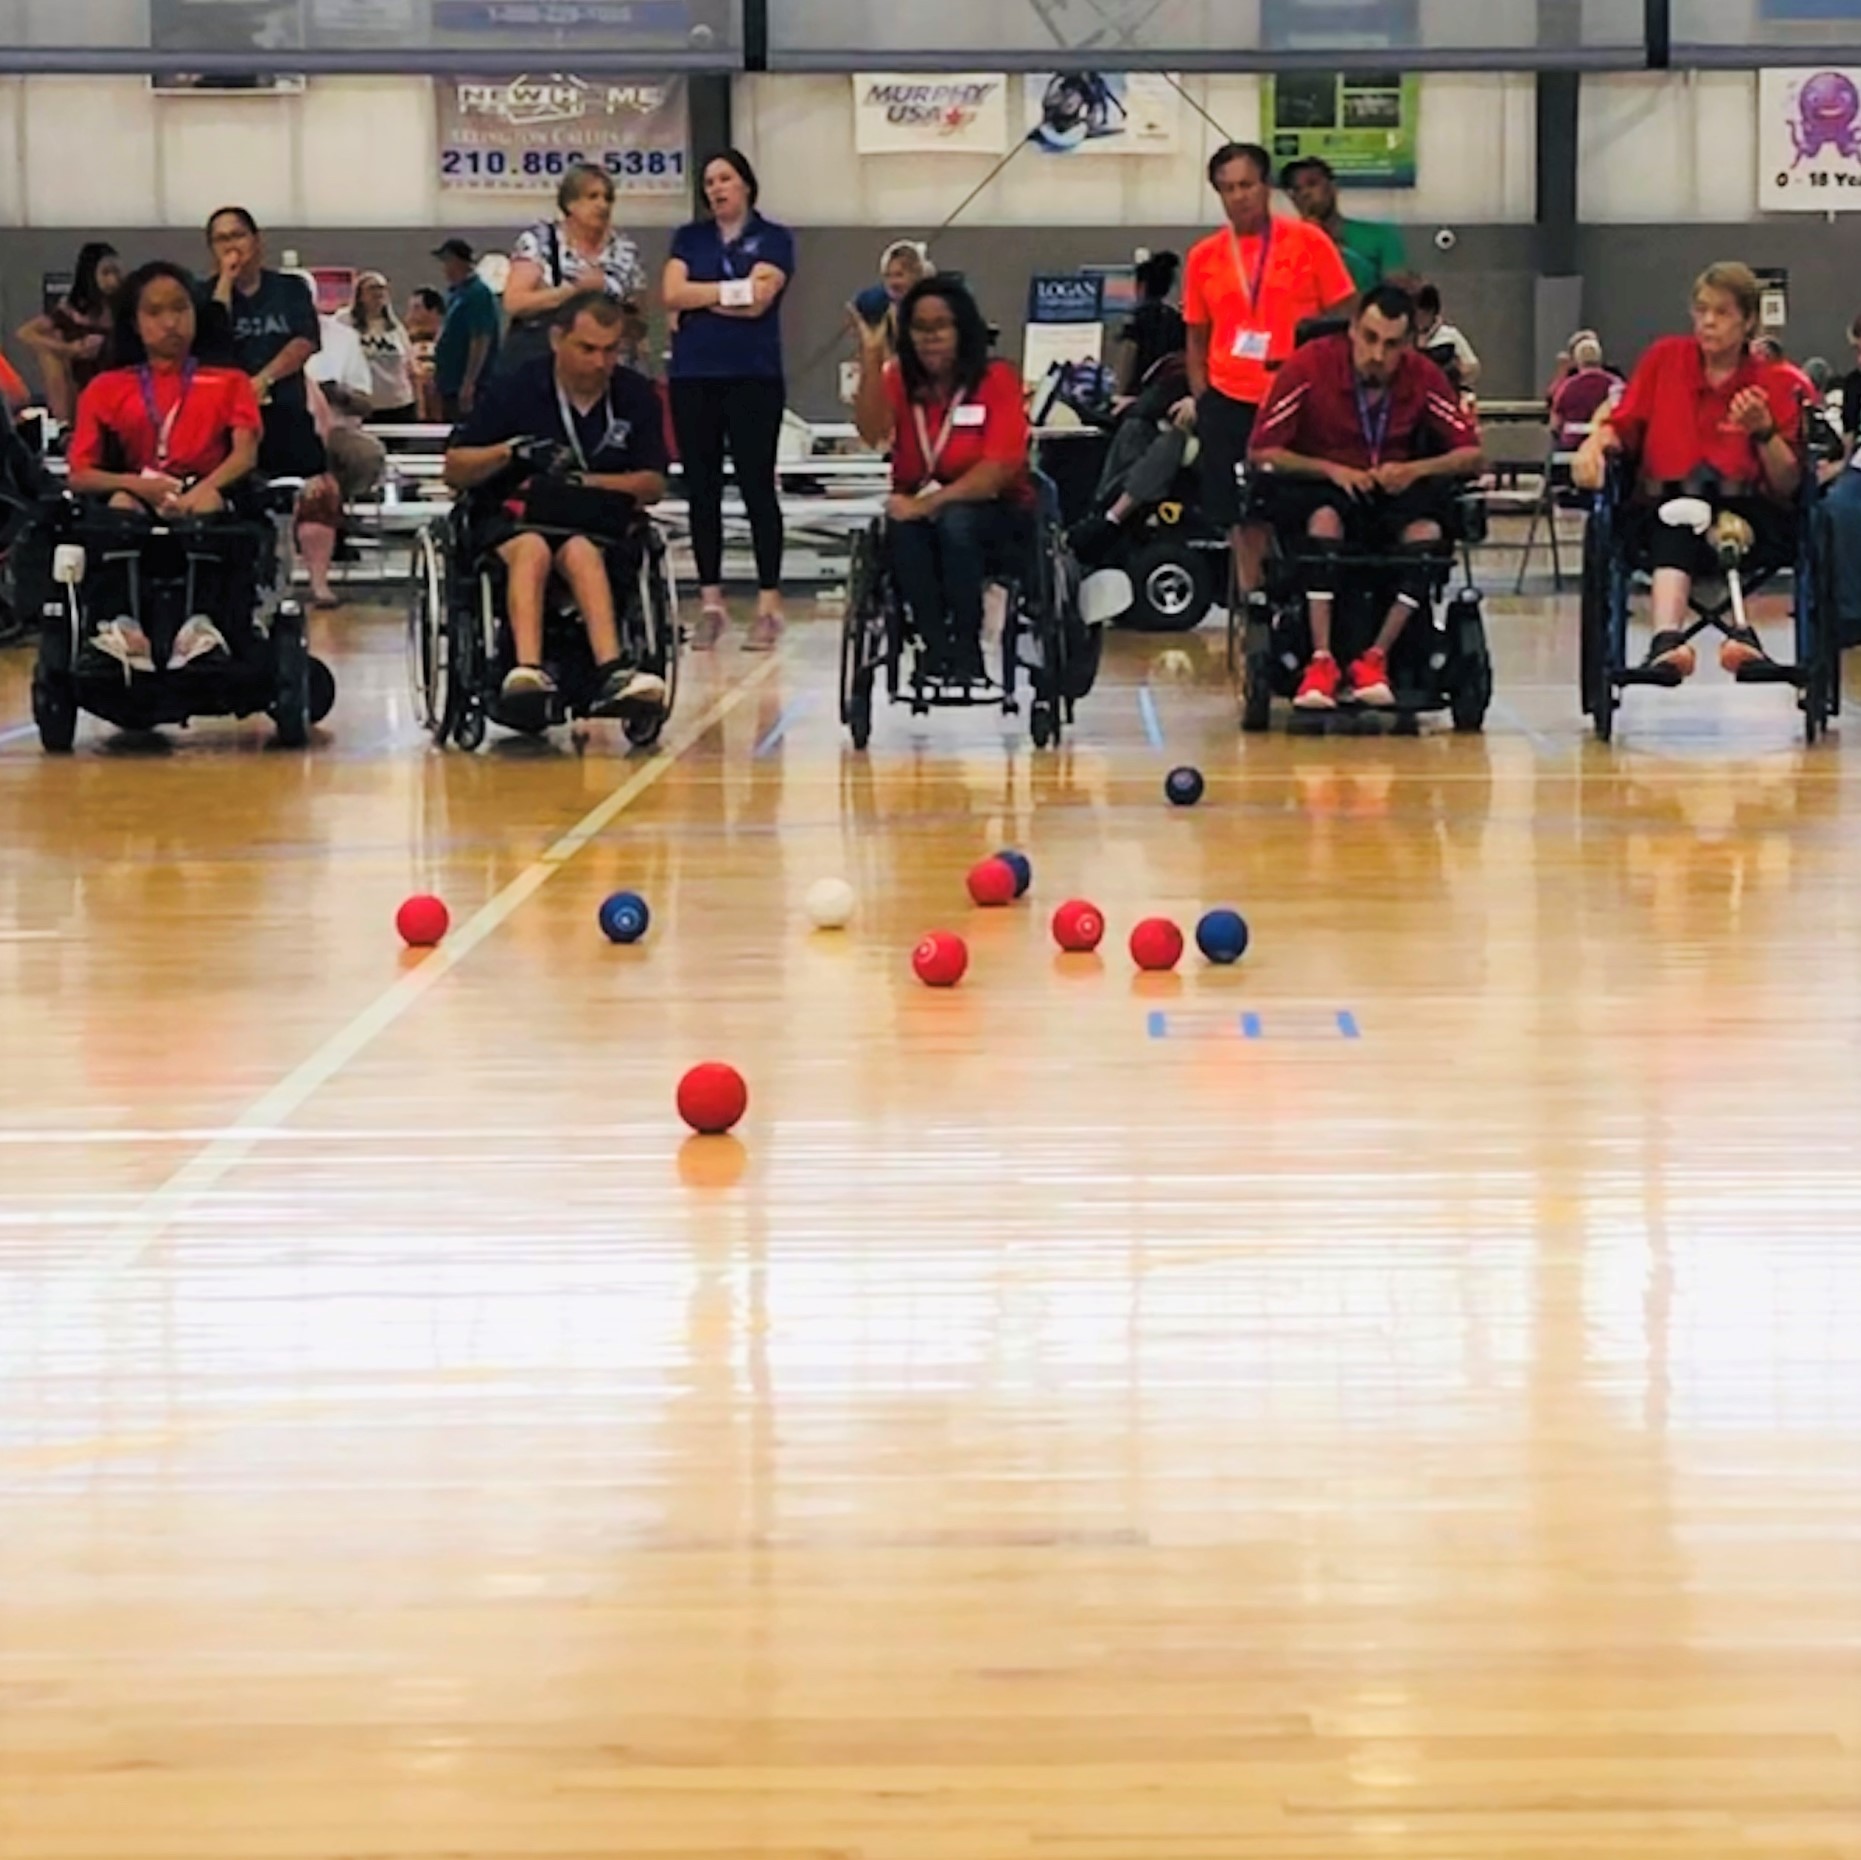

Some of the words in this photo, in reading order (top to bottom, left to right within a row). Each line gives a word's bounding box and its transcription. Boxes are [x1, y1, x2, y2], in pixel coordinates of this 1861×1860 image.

[864, 83, 998, 105] MURPHY
[886, 104, 942, 126] USA
[442, 151, 684, 175] 210.865381
[1809, 172, 1828, 187] 18
[1037, 280, 1097, 298] LOGAN
